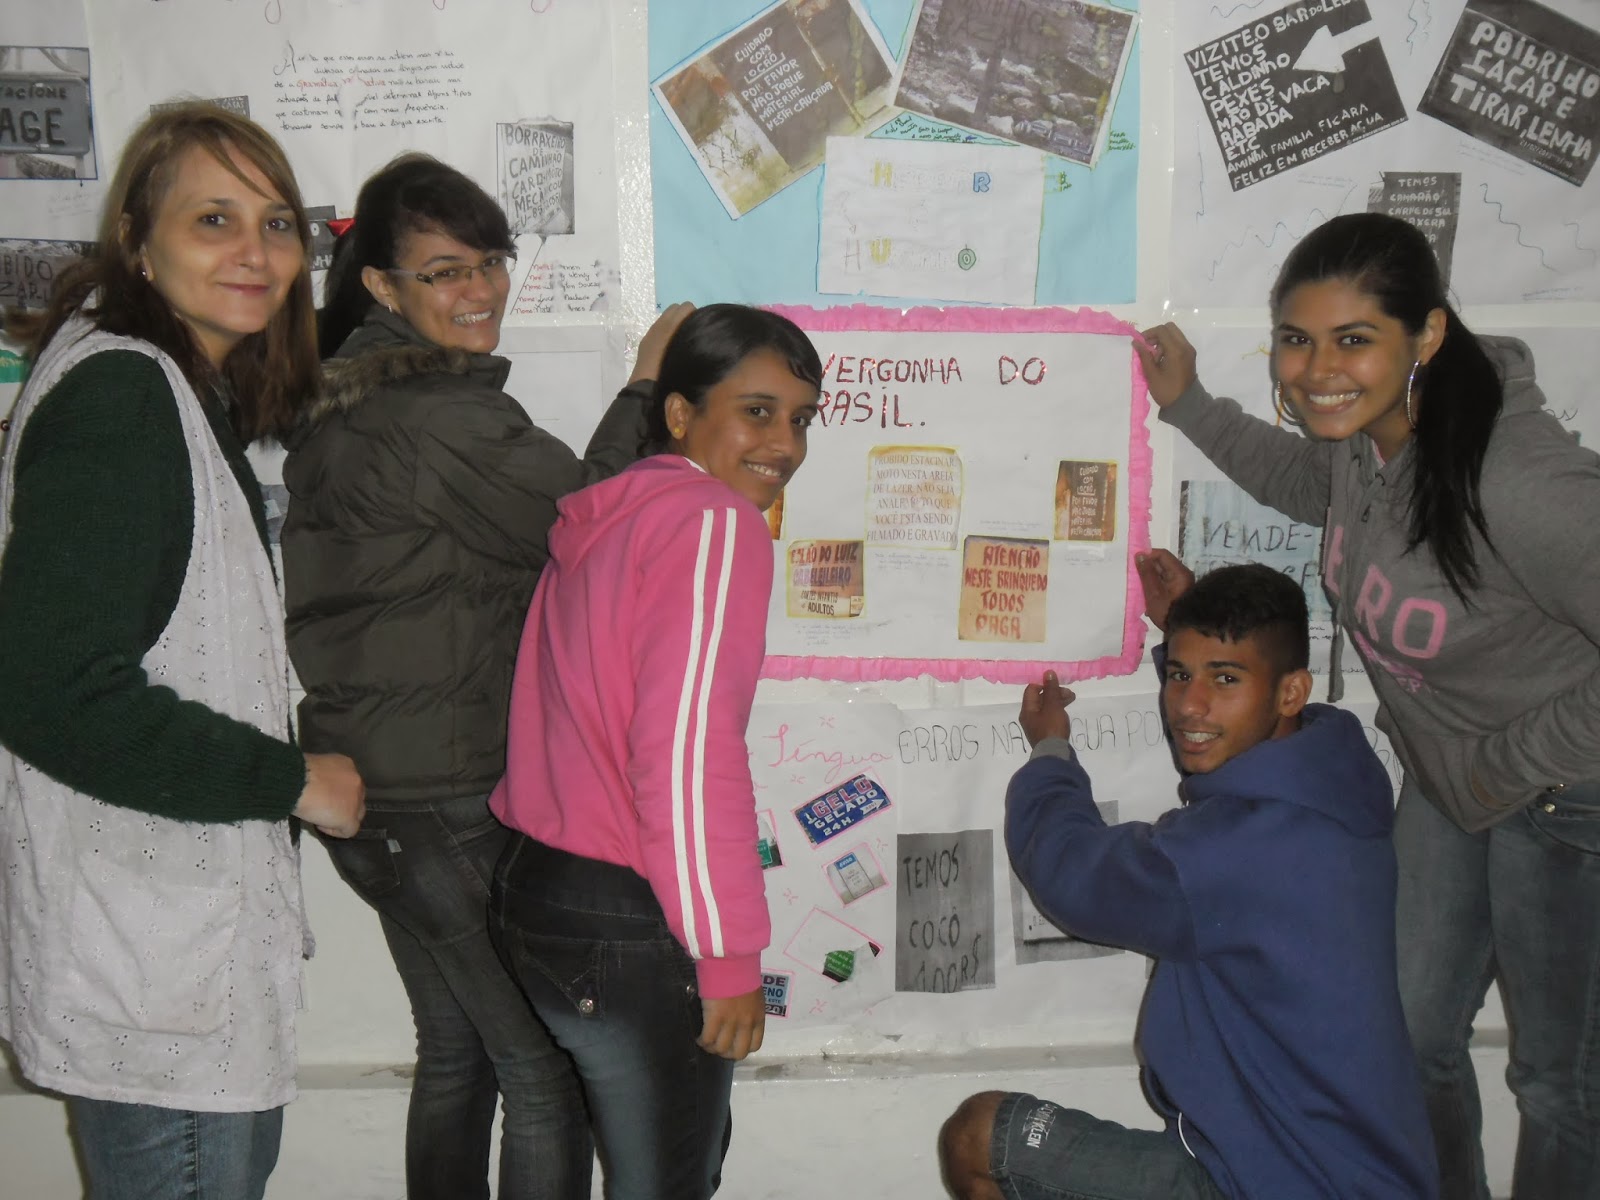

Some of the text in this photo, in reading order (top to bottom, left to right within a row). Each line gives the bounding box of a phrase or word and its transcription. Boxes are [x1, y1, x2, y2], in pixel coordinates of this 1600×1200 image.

[1193, 42, 1267, 87] TEMOS
[1279, 74, 1330, 104] VACA
[1556, 96, 1577, 119] E
[0, 107, 65, 146] AGE
[1220, 106, 1294, 149] RABADA
[1233, 162, 1276, 189] FELIZ
[1276, 153, 1298, 170] EM
[1301, 129, 1349, 160] RECEBER
[998, 355, 1048, 385] DO
[901, 469, 928, 480] NESTA
[867, 528, 906, 541] FILMADO
[923, 512, 953, 525] SENDO
[980, 589, 1026, 614] TODOS
[897, 723, 980, 765] ERROS
[814, 789, 878, 829] GELADO
[902, 842, 959, 897] TEMOS
